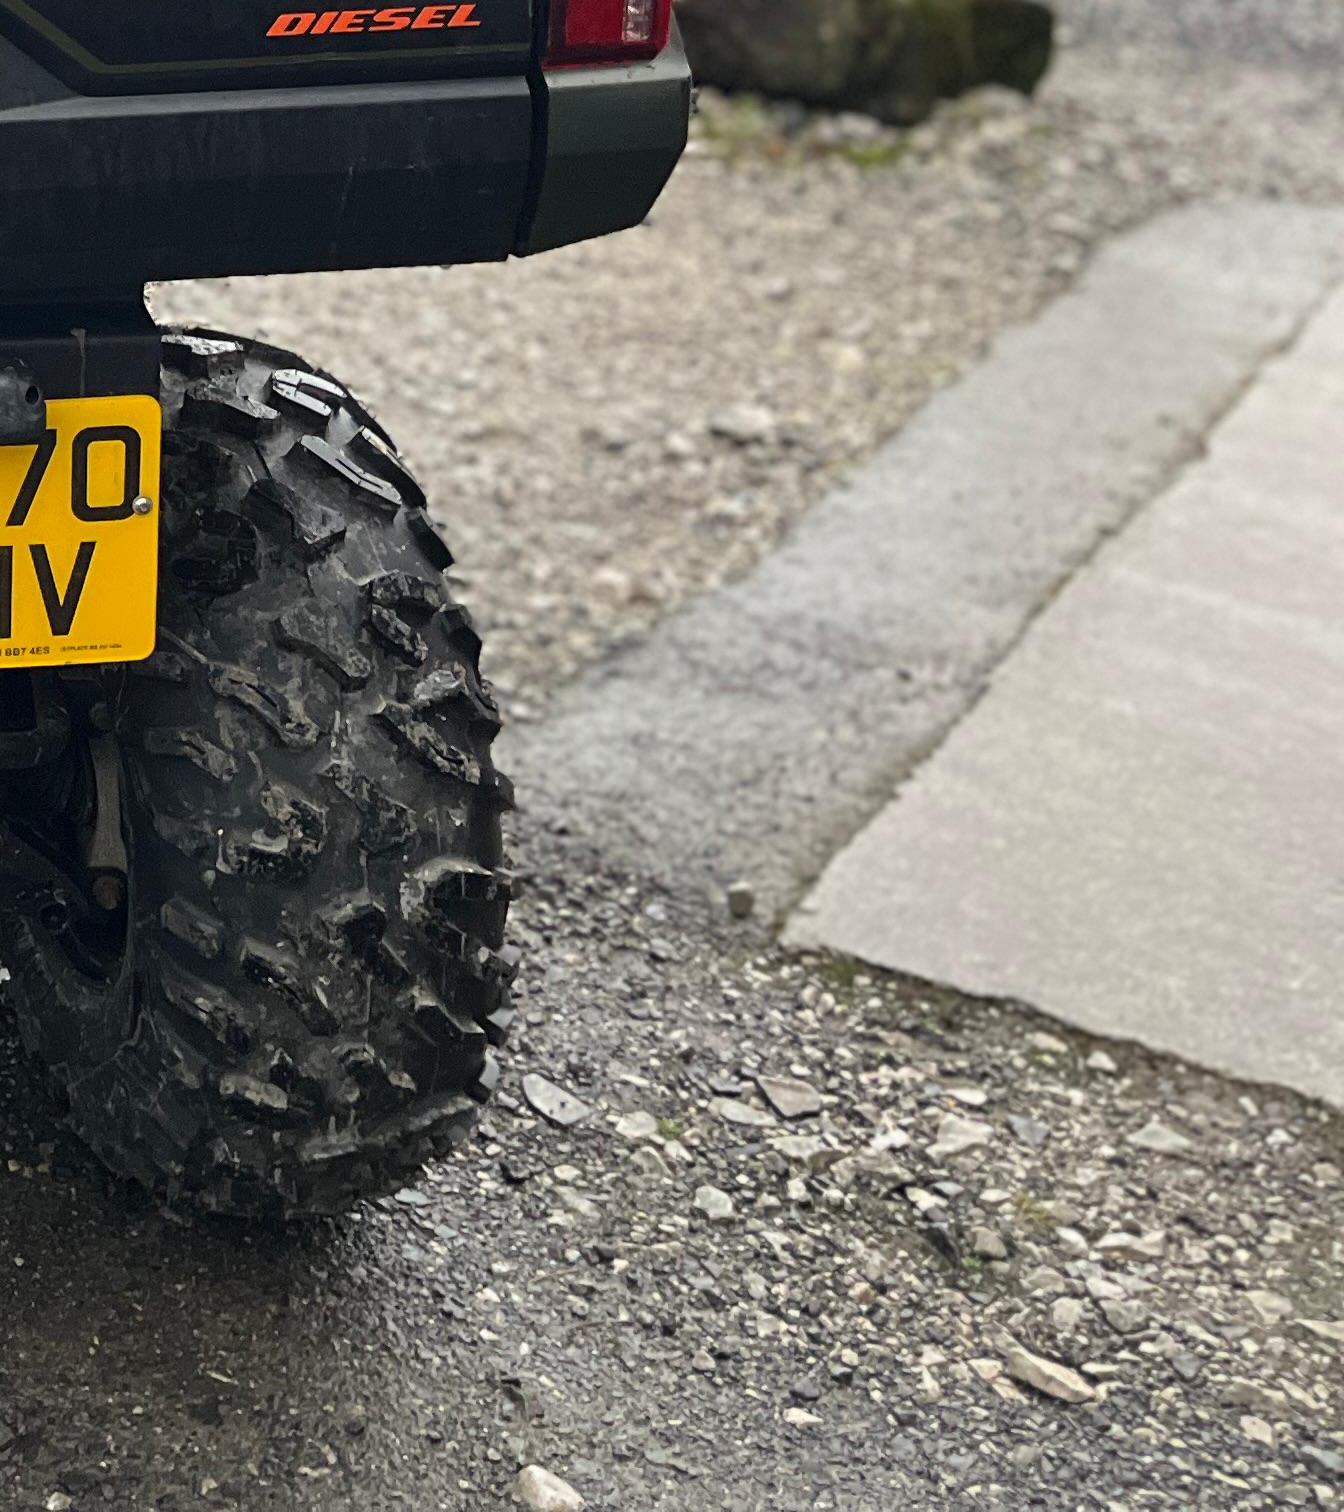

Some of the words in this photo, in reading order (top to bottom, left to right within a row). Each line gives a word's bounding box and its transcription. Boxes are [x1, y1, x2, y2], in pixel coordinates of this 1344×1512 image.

[265, 3, 482, 37] DIESEL
[4, 647, 26, 658] BB7
[29, 646, 51, 656] 4ES
